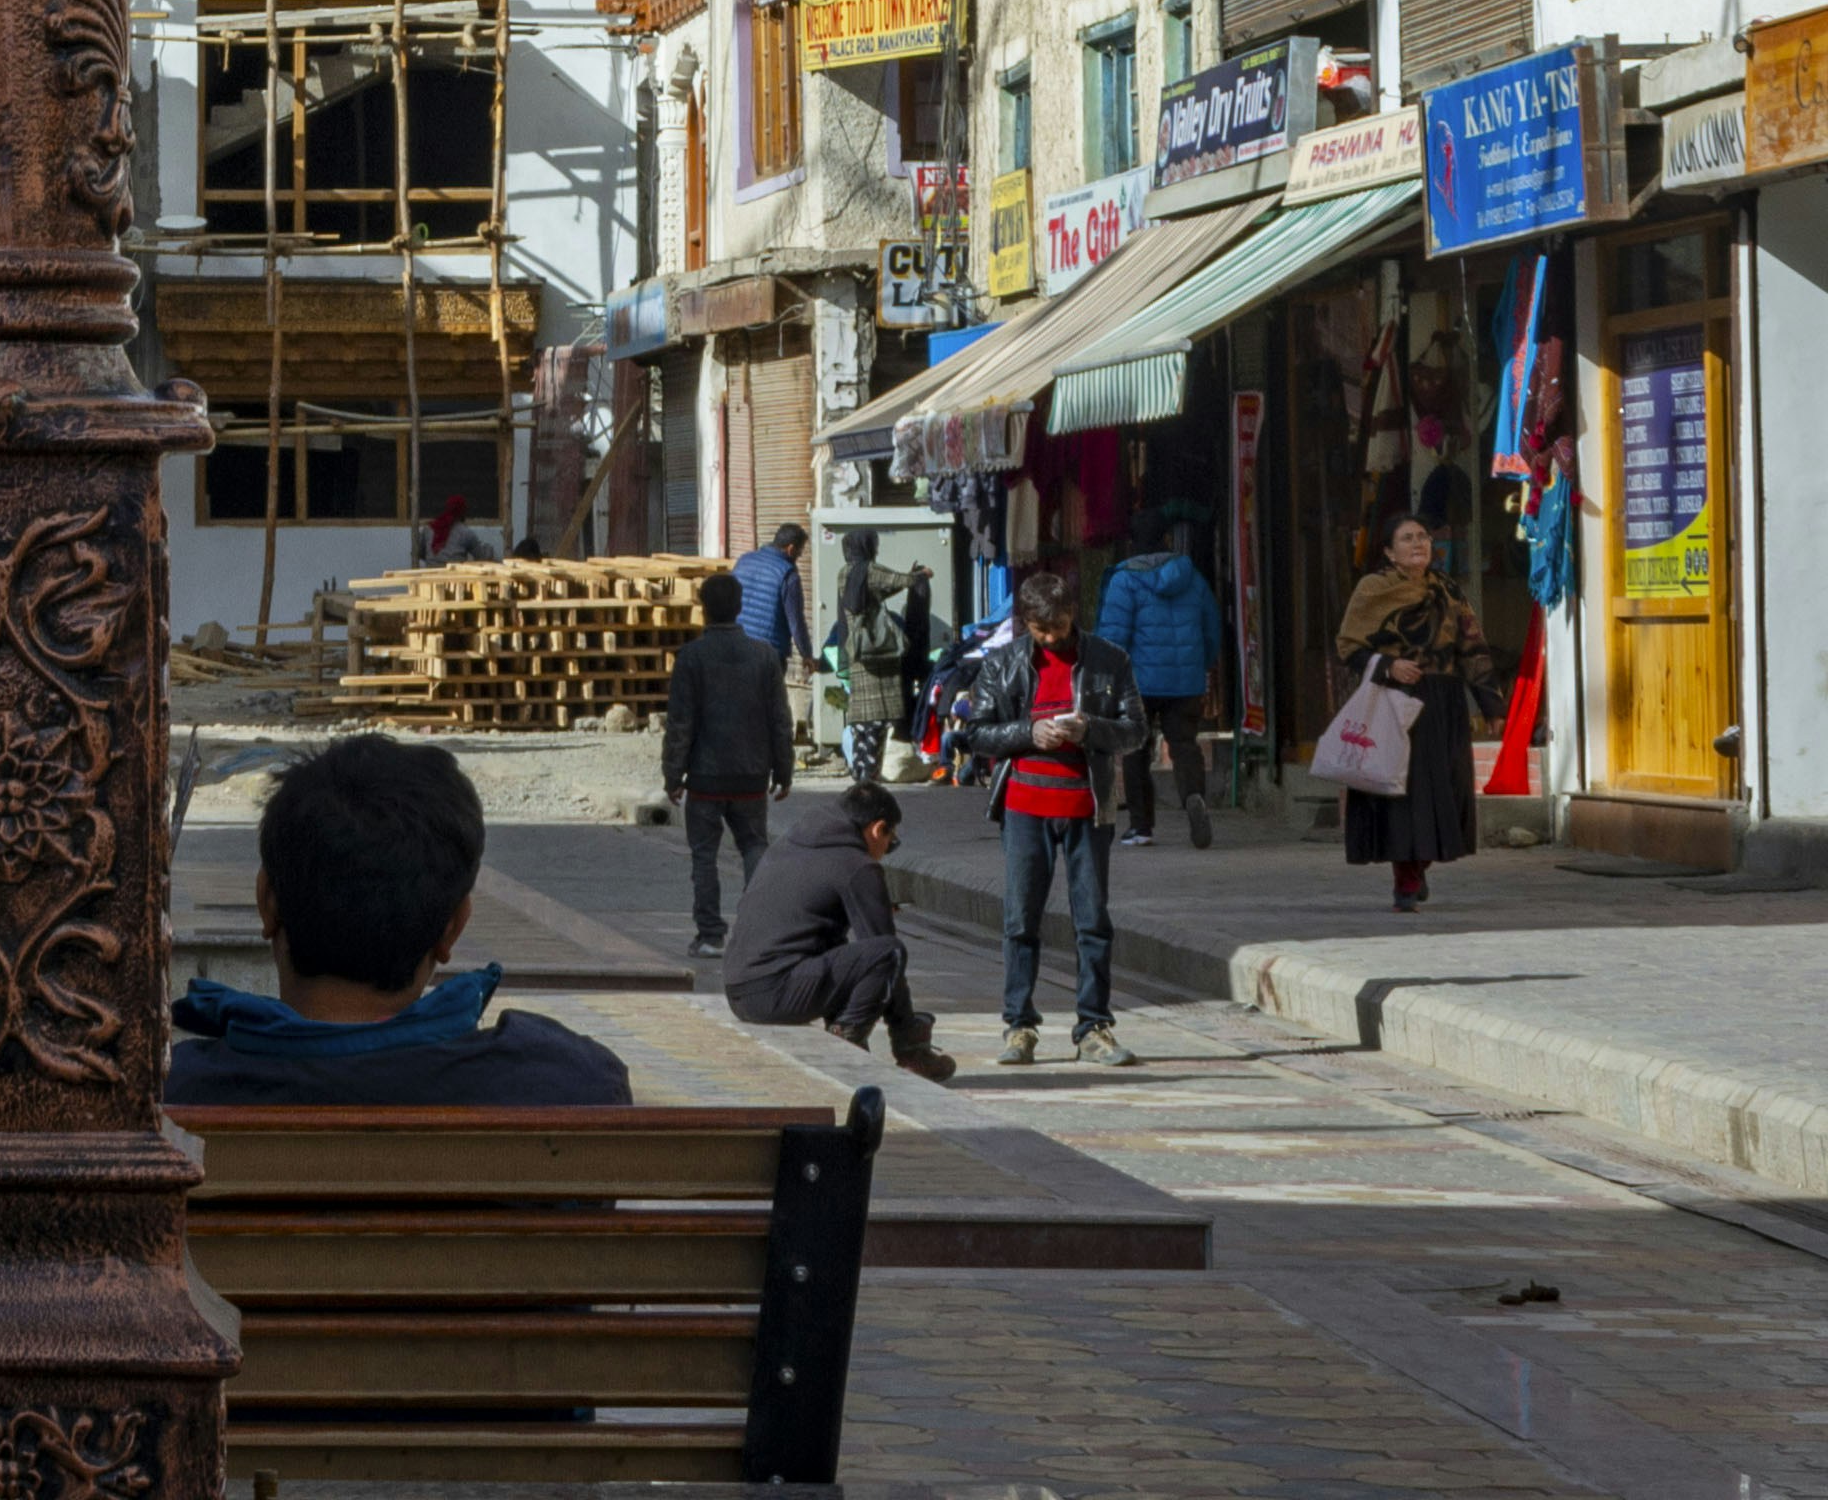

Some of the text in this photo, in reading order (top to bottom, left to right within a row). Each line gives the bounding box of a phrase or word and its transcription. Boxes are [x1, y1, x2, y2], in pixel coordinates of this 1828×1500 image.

[805, 2, 844, 42] WELCOME
[845, 0, 858, 37] TO
[828, 38, 855, 57] PALACE
[856, 36, 875, 54] ROAD
[1172, 69, 1273, 151] Valley Dry Fruits
[1462, 85, 1513, 140] KANG
[1699, 105, 1746, 170] COMPL
[1308, 126, 1384, 169] PASHMINA
[1048, 211, 1080, 274] The
[1086, 198, 1120, 266] Gift
